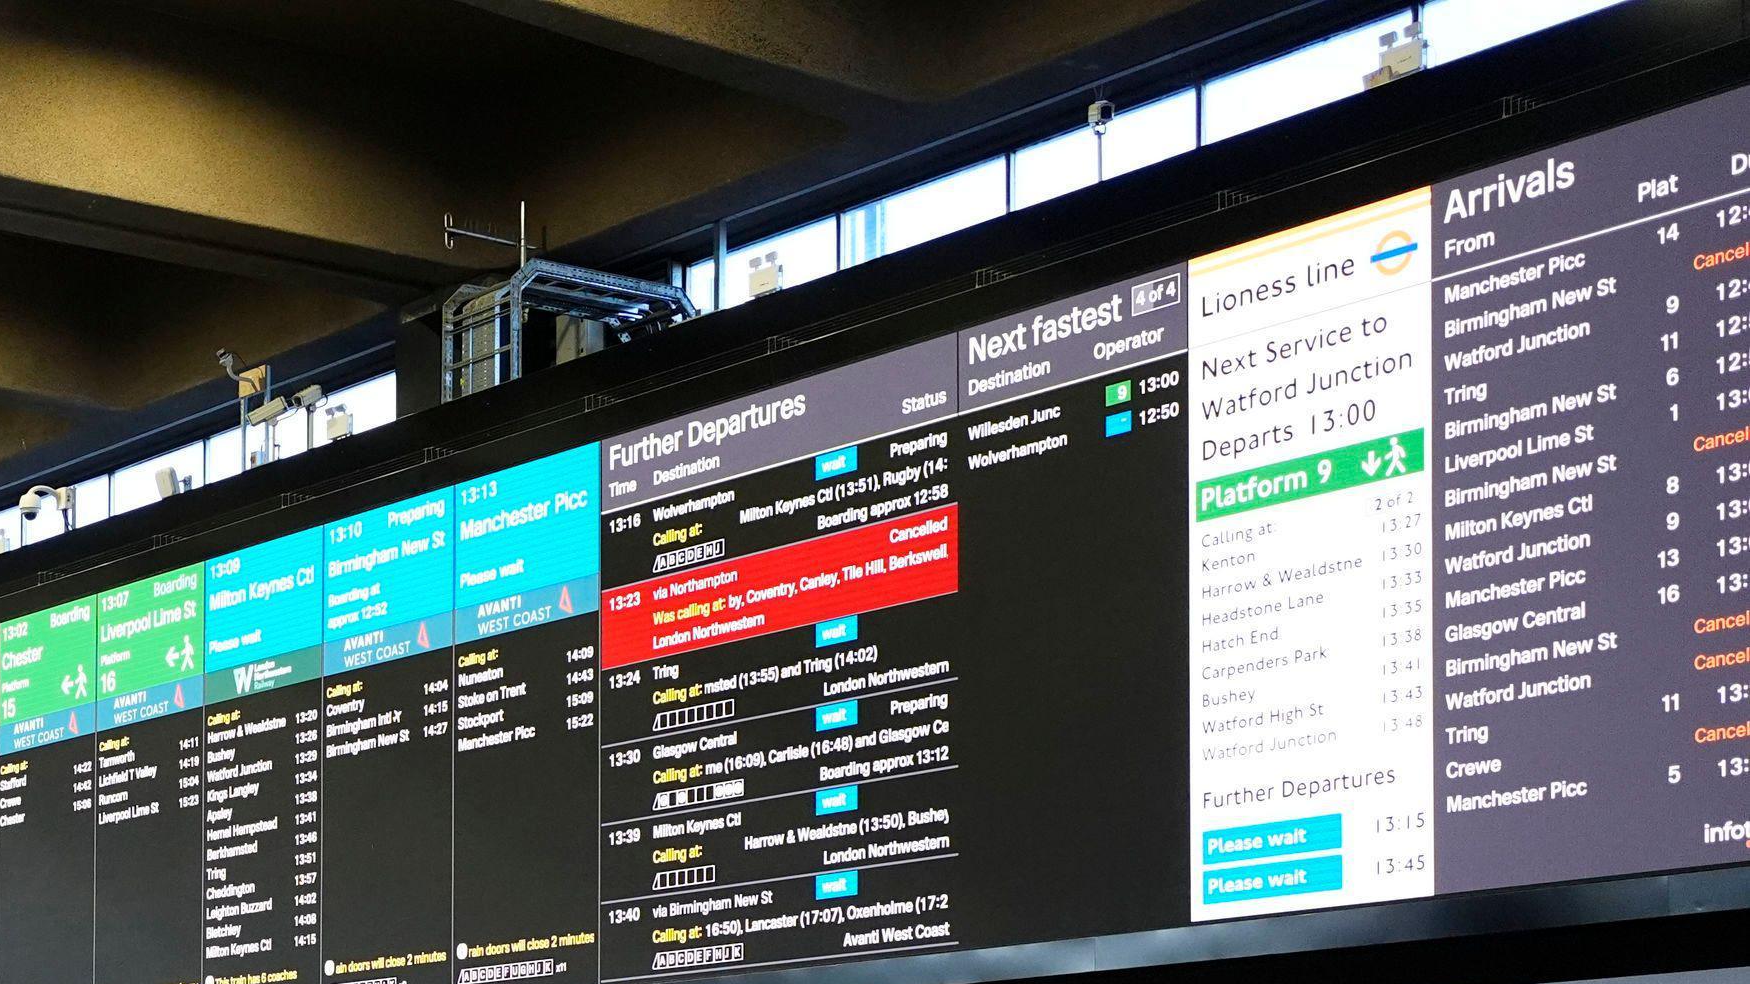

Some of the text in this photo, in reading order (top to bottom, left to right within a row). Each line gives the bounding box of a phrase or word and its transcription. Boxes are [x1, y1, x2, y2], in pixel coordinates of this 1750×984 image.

[1444, 158, 1574, 223] Arrivals
[1638, 175, 1678, 202] Plat
[1445, 232, 1494, 259] From
[1657, 223, 1679, 244] 14
[1203, 259, 1354, 317] Lioness line
[1445, 253, 1585, 304] Manchester Picc
[1136, 281, 1176, 305] 4 of 4
[1666, 296, 1679, 314] 9
[1445, 277, 1616, 338] Birmingham New St
[969, 295, 1122, 364] Next fastest
[1661, 332, 1678, 351] 11
[1094, 328, 1164, 360] Operator
[1203, 317, 1386, 380] Next Service to
[1444, 322, 1590, 371] Watford Junction
[969, 361, 1050, 395] Destination
[1139, 371, 1179, 394] 13:00
[1202, 353, 1411, 420] Watford Junction
[1666, 368, 1679, 385] 6
[902, 391, 946, 414] Status
[1444, 383, 1487, 404] Tring
[968, 406, 1060, 440] Willesden Junc
[1139, 402, 1179, 425] 12:50
[610, 395, 805, 470] Further Departures
[1203, 400, 1375, 460] Departs 13:00
[890, 432, 947, 457] Preparing
[968, 435, 1067, 469] Wolverhampton
[1445, 424, 1594, 473] Liverpool Lime St
[654, 456, 720, 485] Destination
[460, 480, 498, 505] 13:13
[609, 480, 637, 497] Time
[1200, 459, 1331, 512] Platform 9
[388, 499, 444, 528] Preparing
[460, 486, 589, 541] Manchester Picc
[653, 491, 735, 521] Wolverhampton
[1445, 494, 1592, 541] Milton Keynes Ctl
[610, 513, 641, 533] 13:16
[890, 516, 947, 543] Cancelled
[154, 574, 197, 597] Boarding
[460, 559, 525, 588] Please wait
[102, 591, 129, 612] 13:07
[476, 594, 522, 620] AVANTI
[610, 592, 640, 610] 13:23
[1658, 585, 1679, 604] 16
[101, 600, 196, 642] Liverpool Lime St
[478, 604, 552, 636] WEST COAST
[653, 615, 764, 649] London Northwestern
[1445, 601, 1585, 642] Glasgow Central
[2, 646, 43, 670] Chester
[458, 709, 504, 730] Stockport
[609, 749, 640, 767] 13:30
[653, 731, 737, 759] Glasgow Central
[1446, 759, 1501, 778] Crewe
[1204, 770, 1395, 808] Further Departures
[1208, 828, 1307, 855] Please wait
[843, 922, 950, 947] Avanti West Coast
